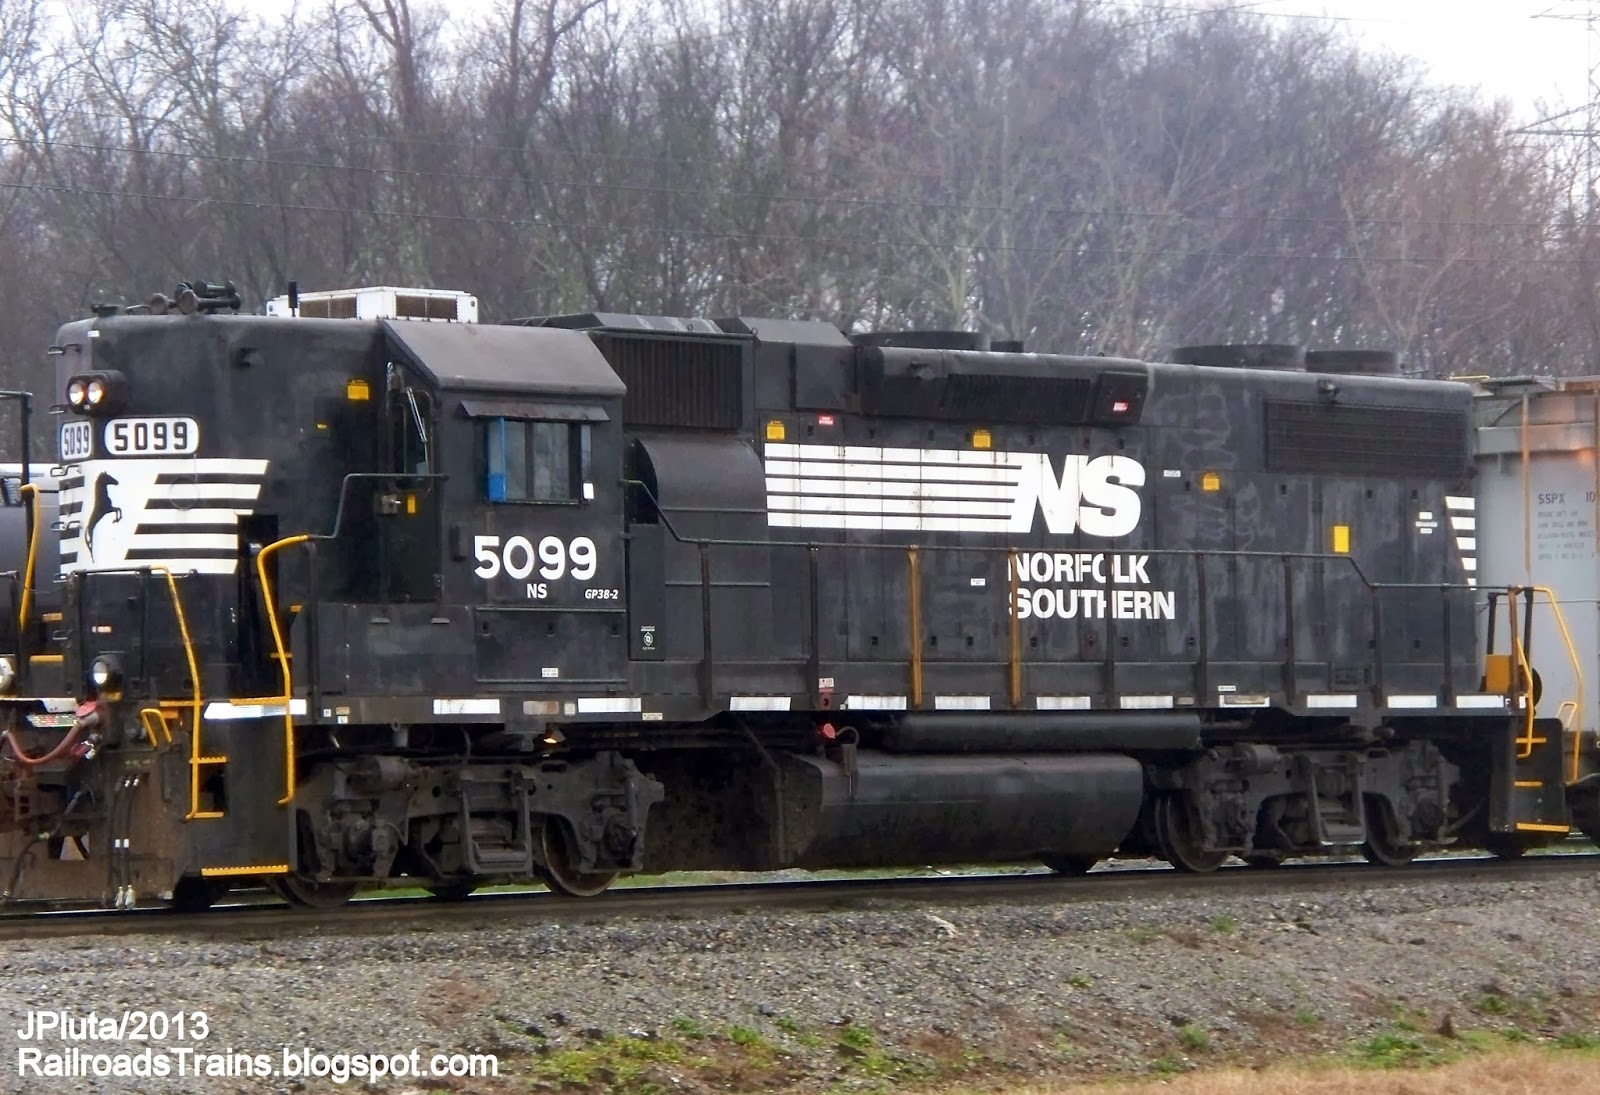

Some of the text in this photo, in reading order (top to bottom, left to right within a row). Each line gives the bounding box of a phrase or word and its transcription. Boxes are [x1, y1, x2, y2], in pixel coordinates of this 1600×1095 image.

[64, 425, 89, 455] 5099
[114, 422, 188, 451] 5099
[1011, 453, 1146, 537] NS
[1538, 493, 1566, 504] SSPX
[474, 535, 597, 580] 5099
[1007, 552, 1151, 584] NORFOLK
[526, 583, 548, 599] NS
[584, 588, 619, 600] GP38-2
[1008, 588, 1176, 620] SOUTHERN
